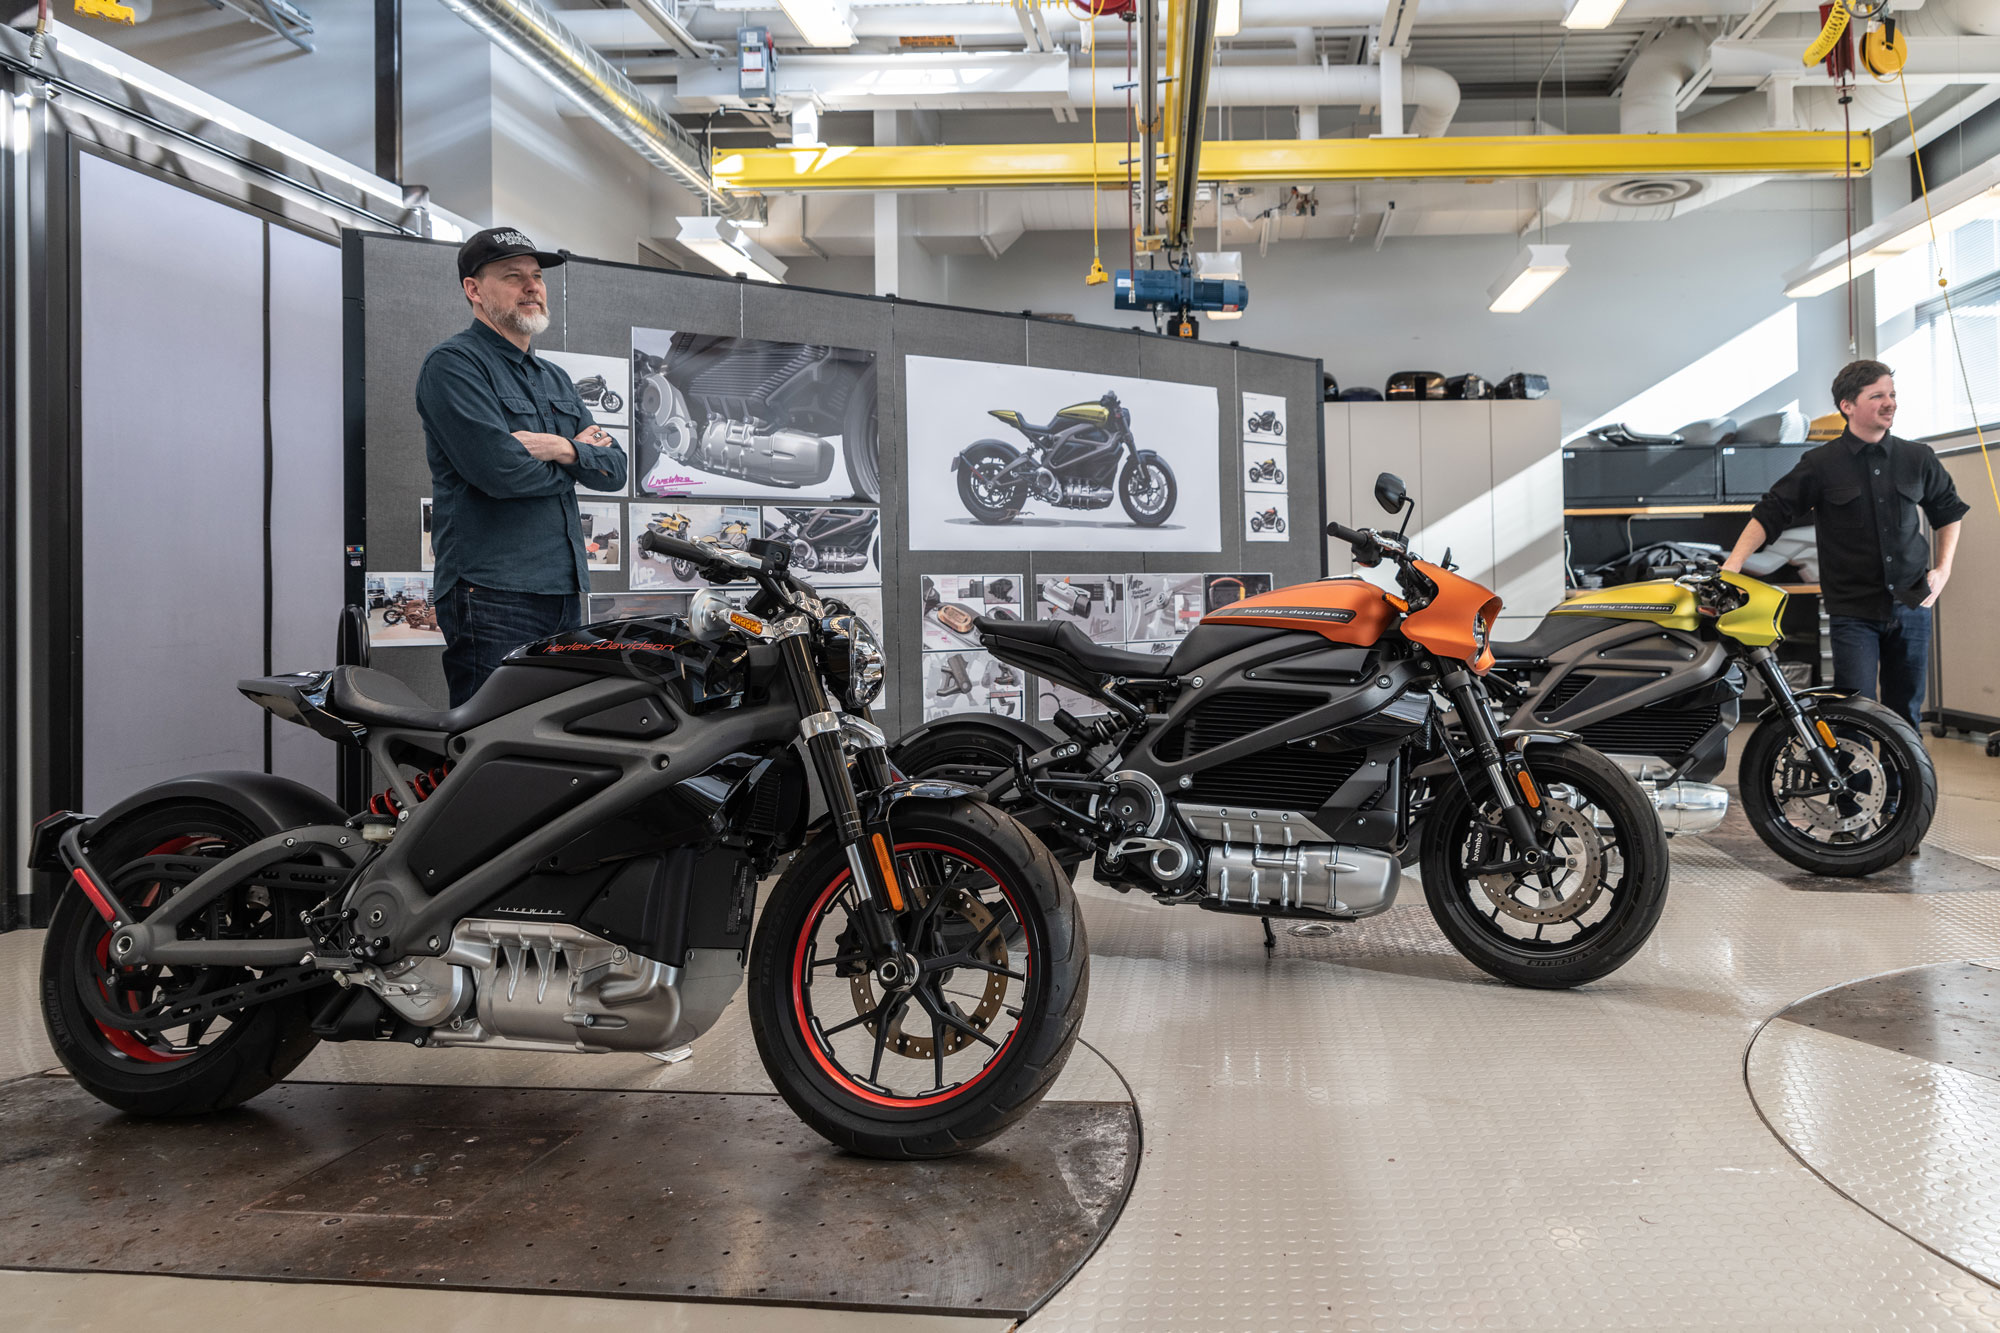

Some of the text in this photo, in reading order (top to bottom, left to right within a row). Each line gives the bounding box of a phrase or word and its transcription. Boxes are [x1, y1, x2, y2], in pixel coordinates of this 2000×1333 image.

[1244, 608, 1349, 618] harley-davidson
[542, 640, 675, 653] Harley-Davidson
[1471, 832, 1483, 861] brembo
[497, 907, 562, 915] LIVEWIRE
[46, 979, 66, 1036] MICHELIN
